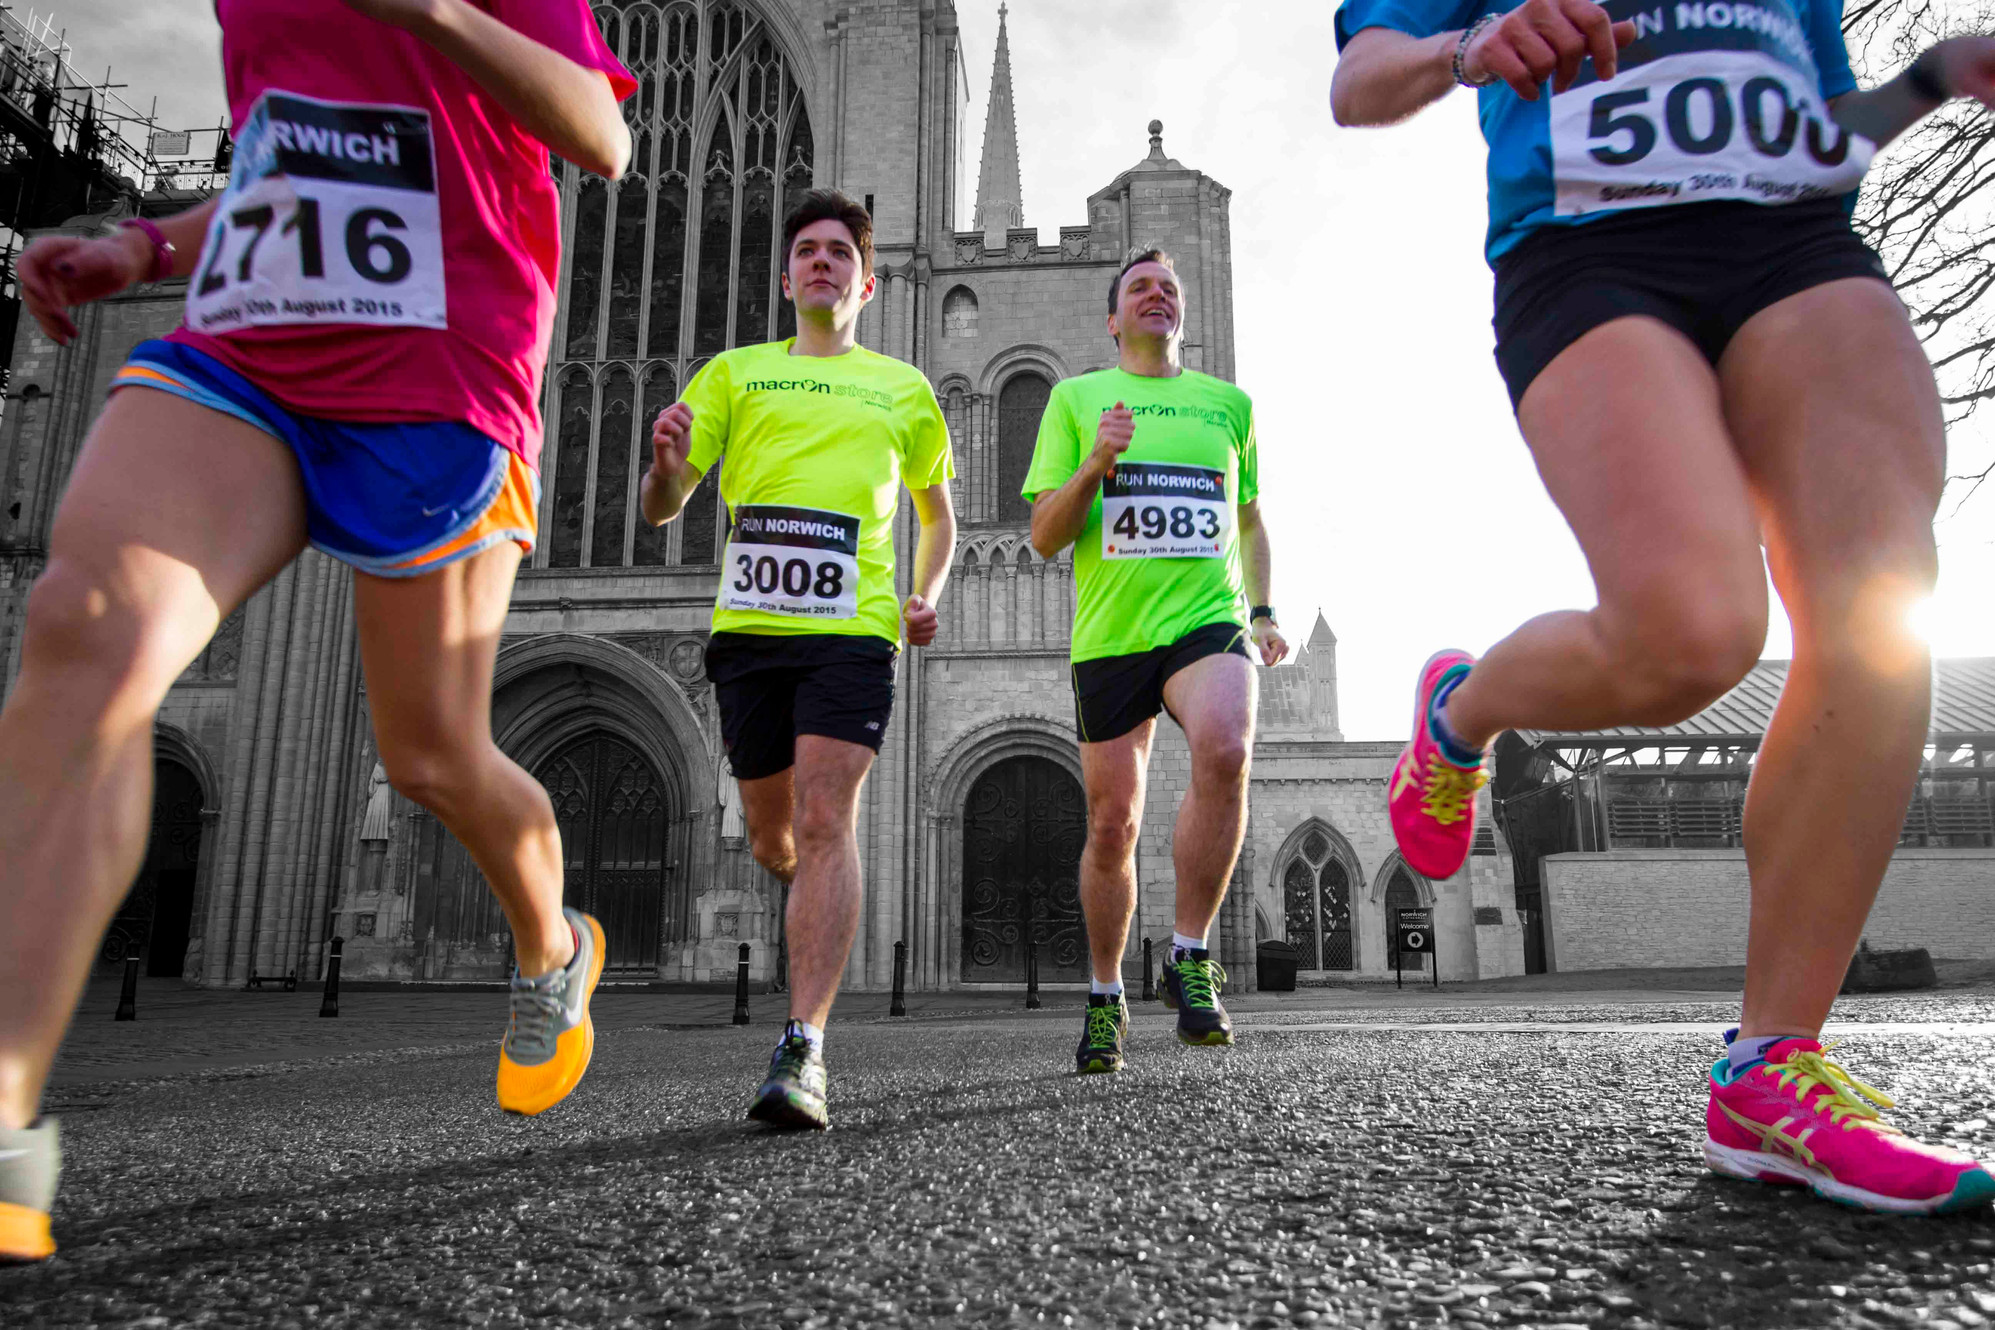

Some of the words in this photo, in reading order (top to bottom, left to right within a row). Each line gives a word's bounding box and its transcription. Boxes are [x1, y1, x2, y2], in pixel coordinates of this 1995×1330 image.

[266, 120, 400, 166] RWICH
[281, 298, 346, 317] August
[352, 298, 404, 316] 2015
[746, 379, 830, 394] macron
[834, 384, 893, 404] store
[1102, 404, 1176, 416] cron
[1116, 473, 1142, 487] RUN
[1147, 473, 1215, 492] NORWICH
[741, 518, 763, 531] RUN
[766, 518, 845, 540] NORWICH
[1113, 506, 1220, 540] 4983
[1118, 547, 1147, 556] Sunday
[1170, 546, 1197, 555] August
[734, 554, 843, 599] 3008
[730, 598, 755, 609] Sunday
[758, 601, 777, 611] 30th
[779, 604, 811, 614] August
[814, 606, 836, 614] 2015
